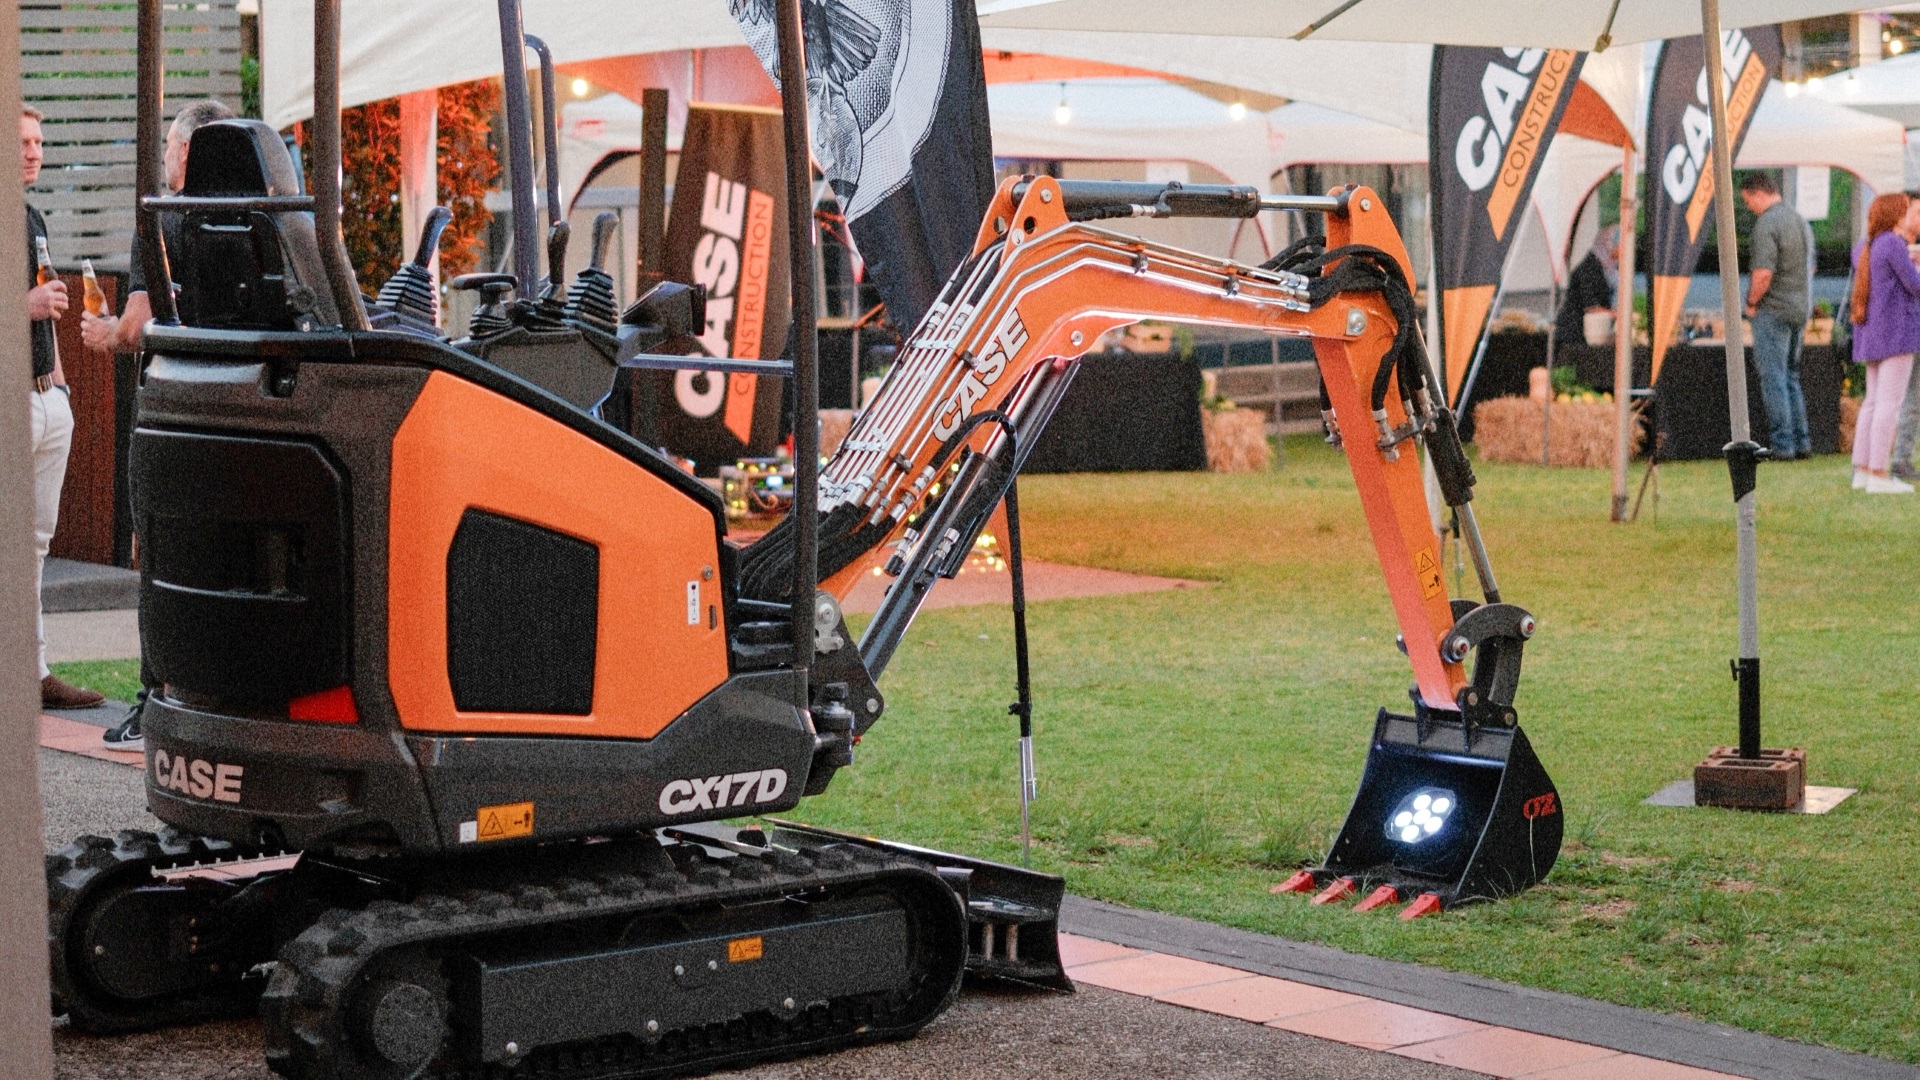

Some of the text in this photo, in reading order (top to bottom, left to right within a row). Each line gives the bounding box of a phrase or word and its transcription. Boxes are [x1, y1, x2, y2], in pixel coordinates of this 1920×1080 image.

[1503, 48, 1570, 188] CONSTRUC
[674, 171, 747, 418] CASE
[932, 307, 1030, 443] CASE
[155, 749, 244, 803] CASE
[659, 768, 788, 815] CX17D
